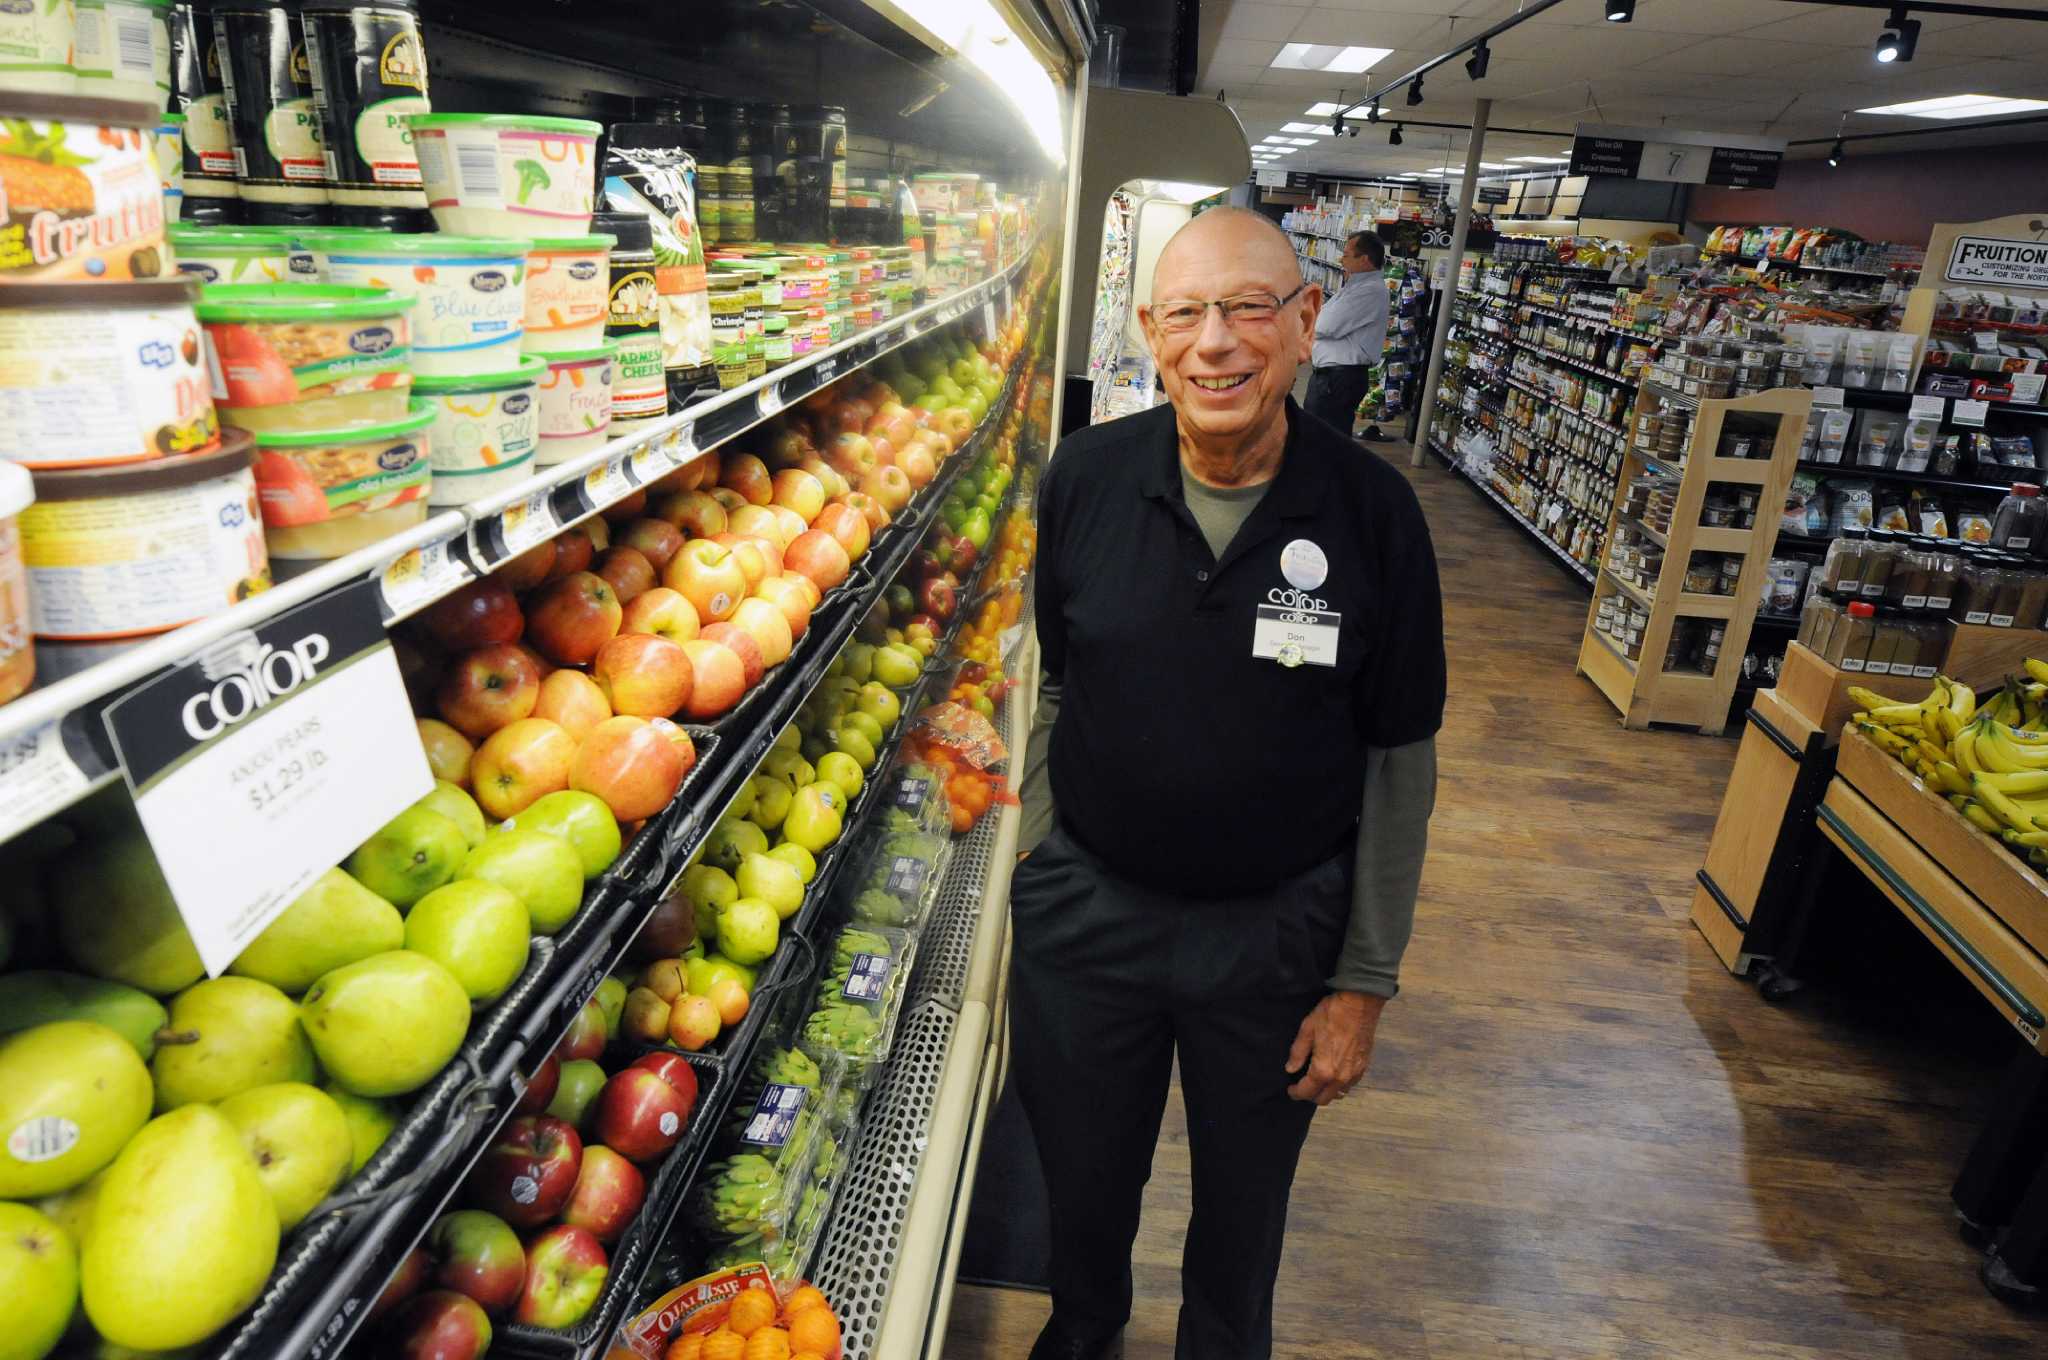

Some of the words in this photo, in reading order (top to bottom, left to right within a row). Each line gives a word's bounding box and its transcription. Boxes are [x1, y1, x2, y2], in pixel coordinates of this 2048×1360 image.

[1668, 151, 1682, 175] 7
[1957, 242, 2048, 265] FRUITION
[1981, 262, 2030, 272] CUSTOMIZING
[1992, 270, 2009, 279] FOR
[2011, 271, 2025, 280] THE
[1287, 632, 1305, 642] Don
